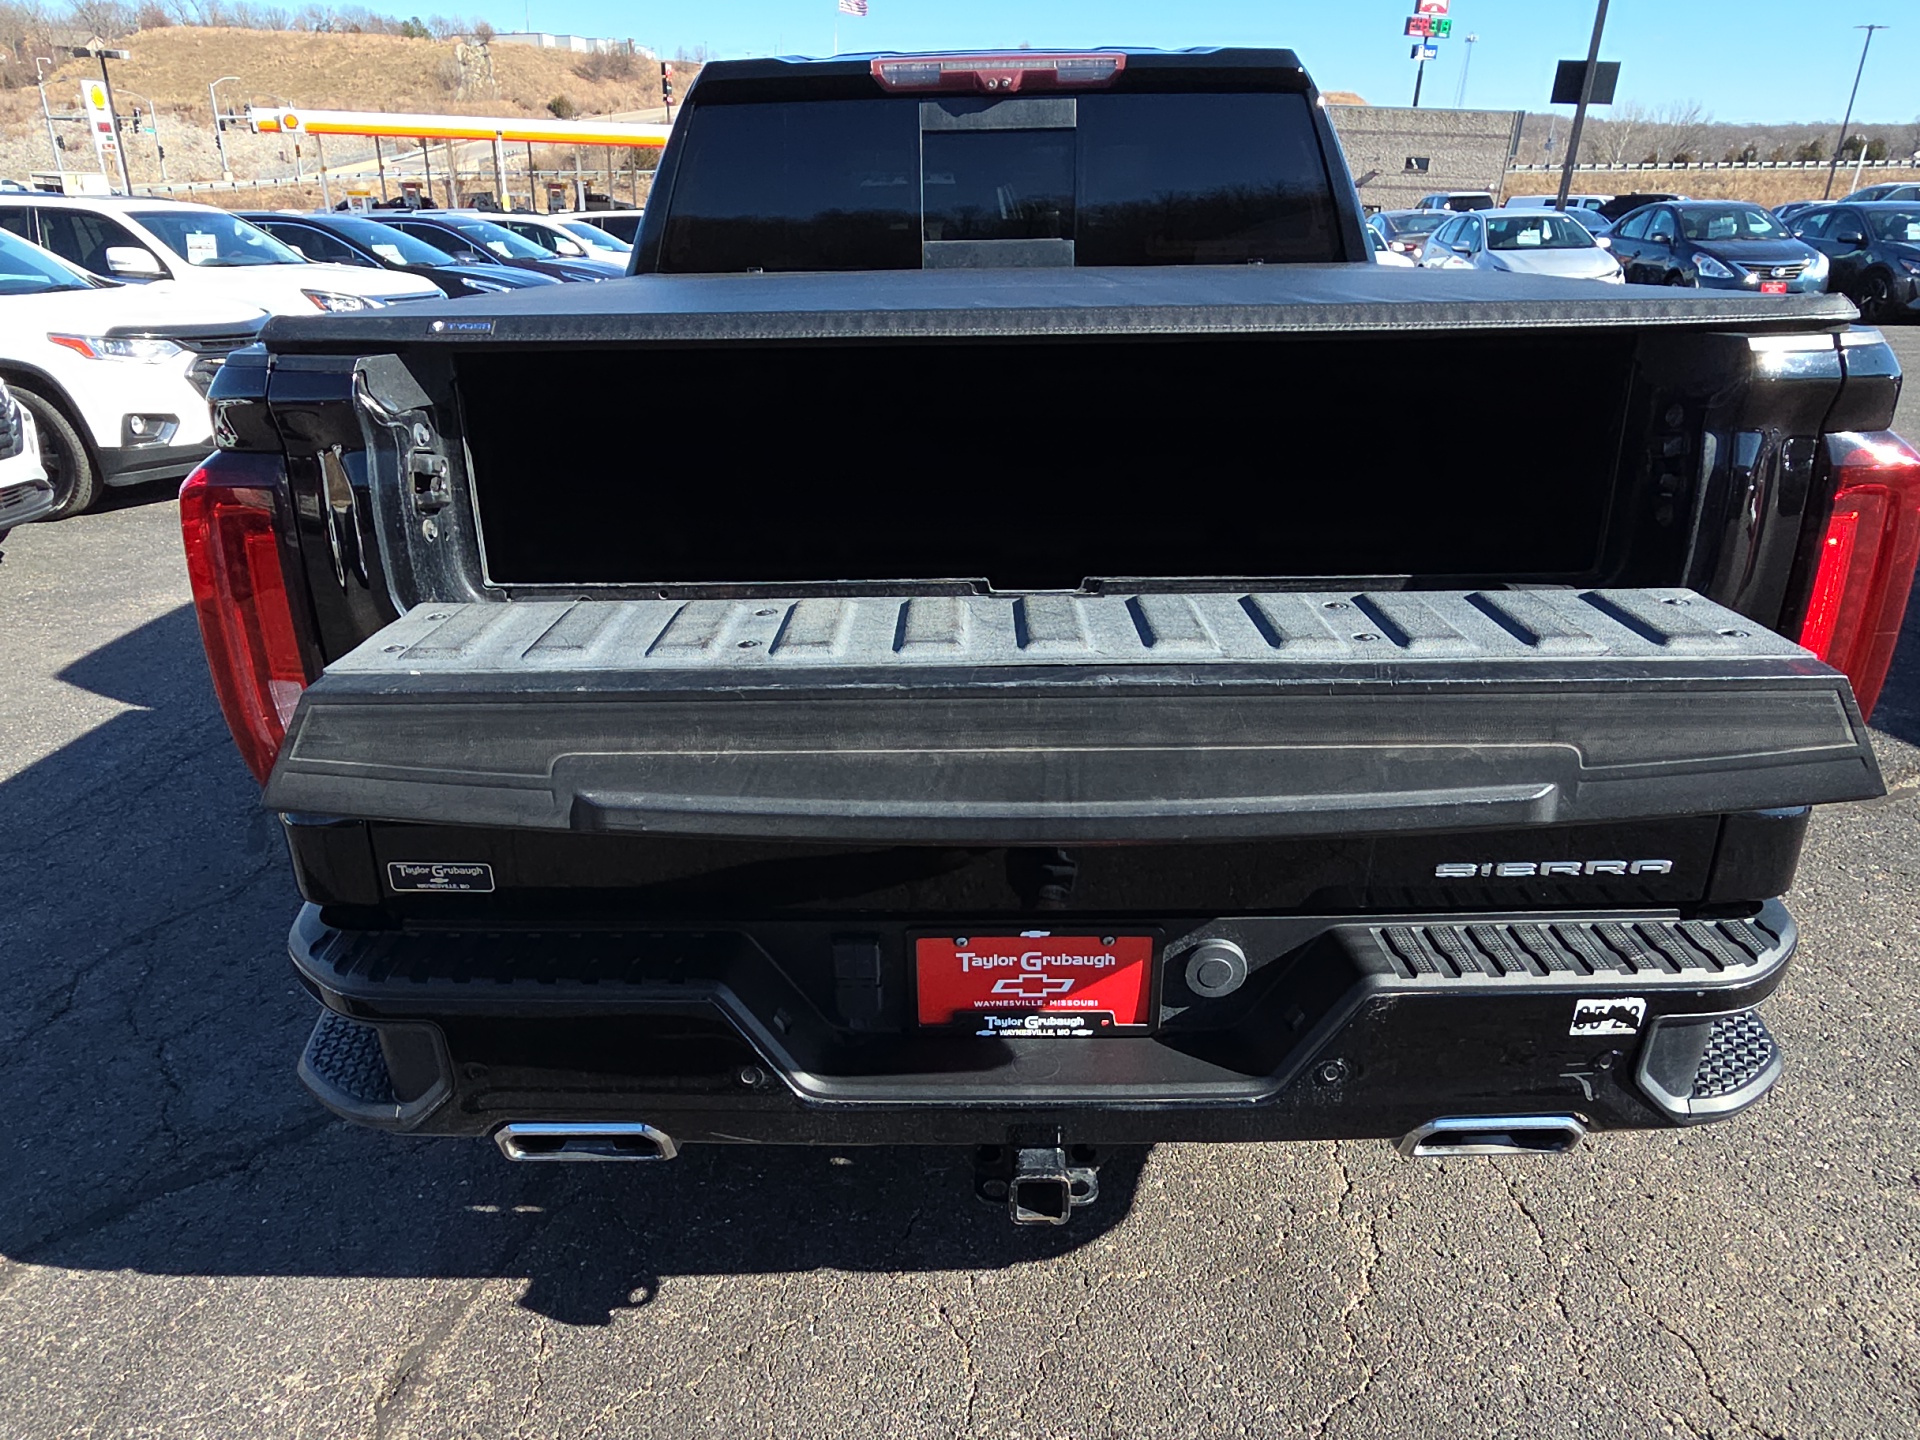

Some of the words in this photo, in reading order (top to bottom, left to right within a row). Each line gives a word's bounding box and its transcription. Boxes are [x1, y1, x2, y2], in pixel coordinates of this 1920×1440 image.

[396, 865, 430, 877] Taylor
[431, 865, 483, 877] Grubaugh
[1435, 859, 1673, 877] SIERRA
[955, 952, 1017, 972] Taylor
[1020, 951, 1116, 971] Grubaugh
[1049, 999, 1099, 1007] MISSOURI
[983, 1015, 1023, 1029] Taylor
[1024, 1015, 1085, 1029] Grubaugh
[1057, 1028, 1070, 1036] MO
